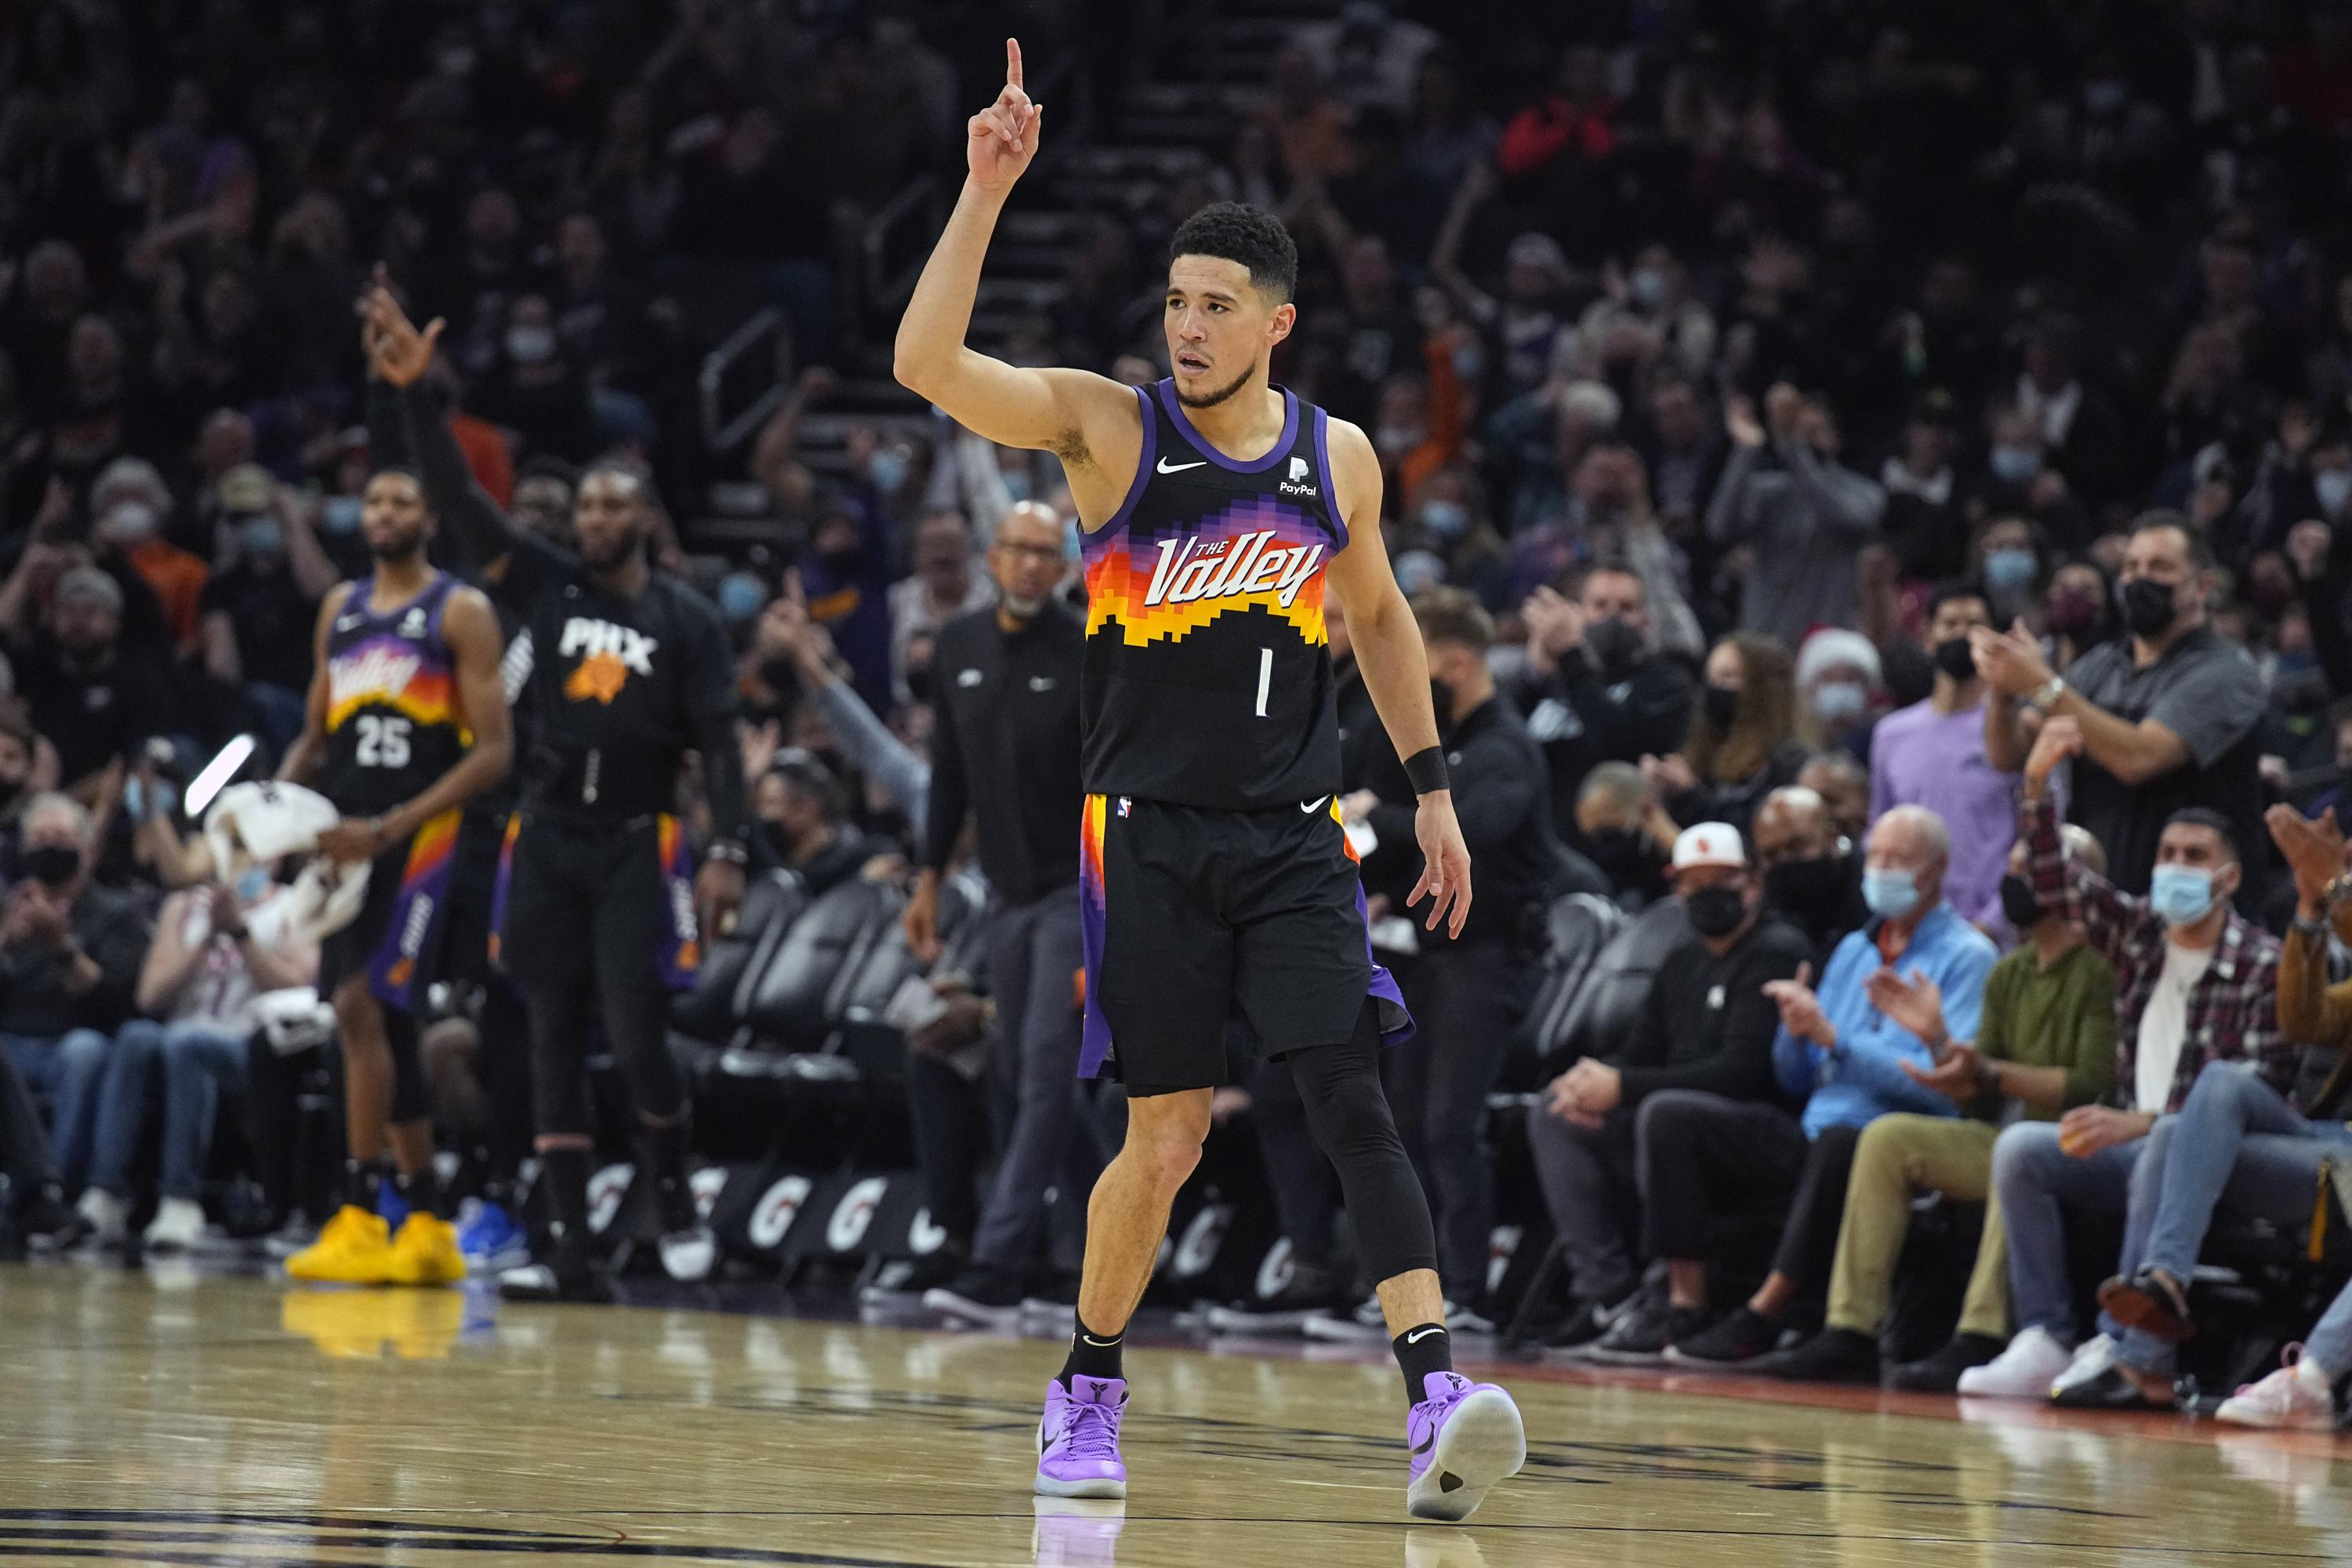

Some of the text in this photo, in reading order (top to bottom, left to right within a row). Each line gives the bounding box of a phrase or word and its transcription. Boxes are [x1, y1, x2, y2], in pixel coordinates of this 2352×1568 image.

[1279, 481, 1316, 496] PayPal
[1144, 530, 1324, 608] Valley
[1195, 540, 1229, 557] THE
[1256, 648, 1273, 717] 1
[355, 715, 412, 769] 25
